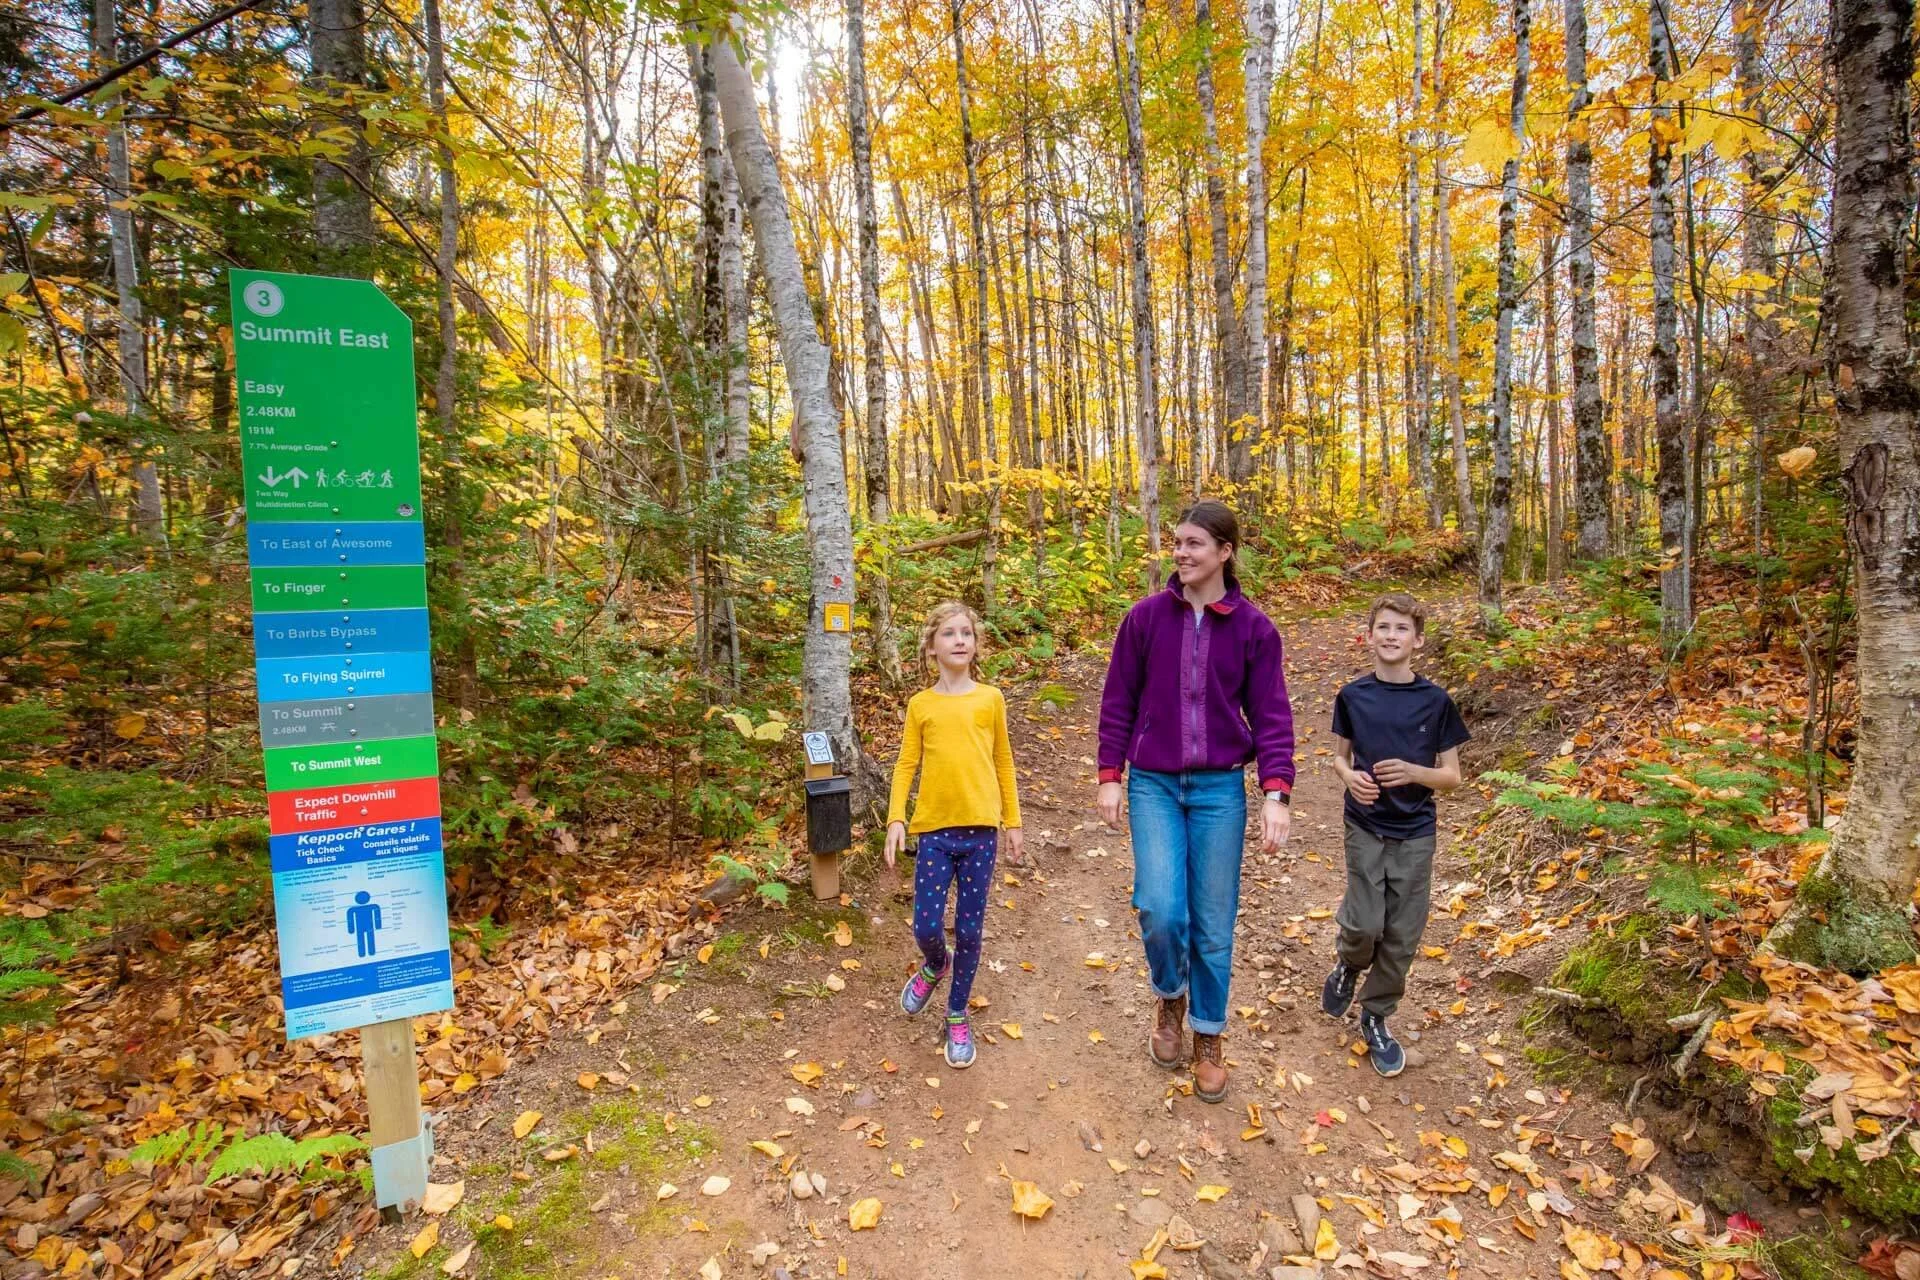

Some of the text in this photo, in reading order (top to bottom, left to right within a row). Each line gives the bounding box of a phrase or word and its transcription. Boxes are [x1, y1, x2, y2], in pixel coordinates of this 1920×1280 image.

[258, 290, 270, 307] 3
[240, 322, 389, 349] Summit East
[244, 380, 284, 396] Easy
[246, 406, 296, 418] 2.48KM
[248, 426, 274, 435] 191M
[270, 444, 302, 452] Average
[260, 538, 392, 549] To East of Awesome
[263, 582, 326, 596] To Finger
[267, 627, 376, 640] To Barbs Bypass
[283, 669, 385, 684] To Flying Squirrel
[272, 706, 342, 720] To Summit
[272, 725, 306, 735] 2.48KM
[290, 755, 382, 772] To Summit West
[294, 788, 396, 808] Expect Downhill
[296, 809, 337, 822] Traffic
[298, 828, 361, 846] Keppoch
[366, 824, 407, 837] Cares
[362, 834, 430, 849] Conseils relatifs
[296, 845, 345, 857] Tick Check
[375, 844, 418, 856] aux tiques
[307, 854, 336, 865] Basics
